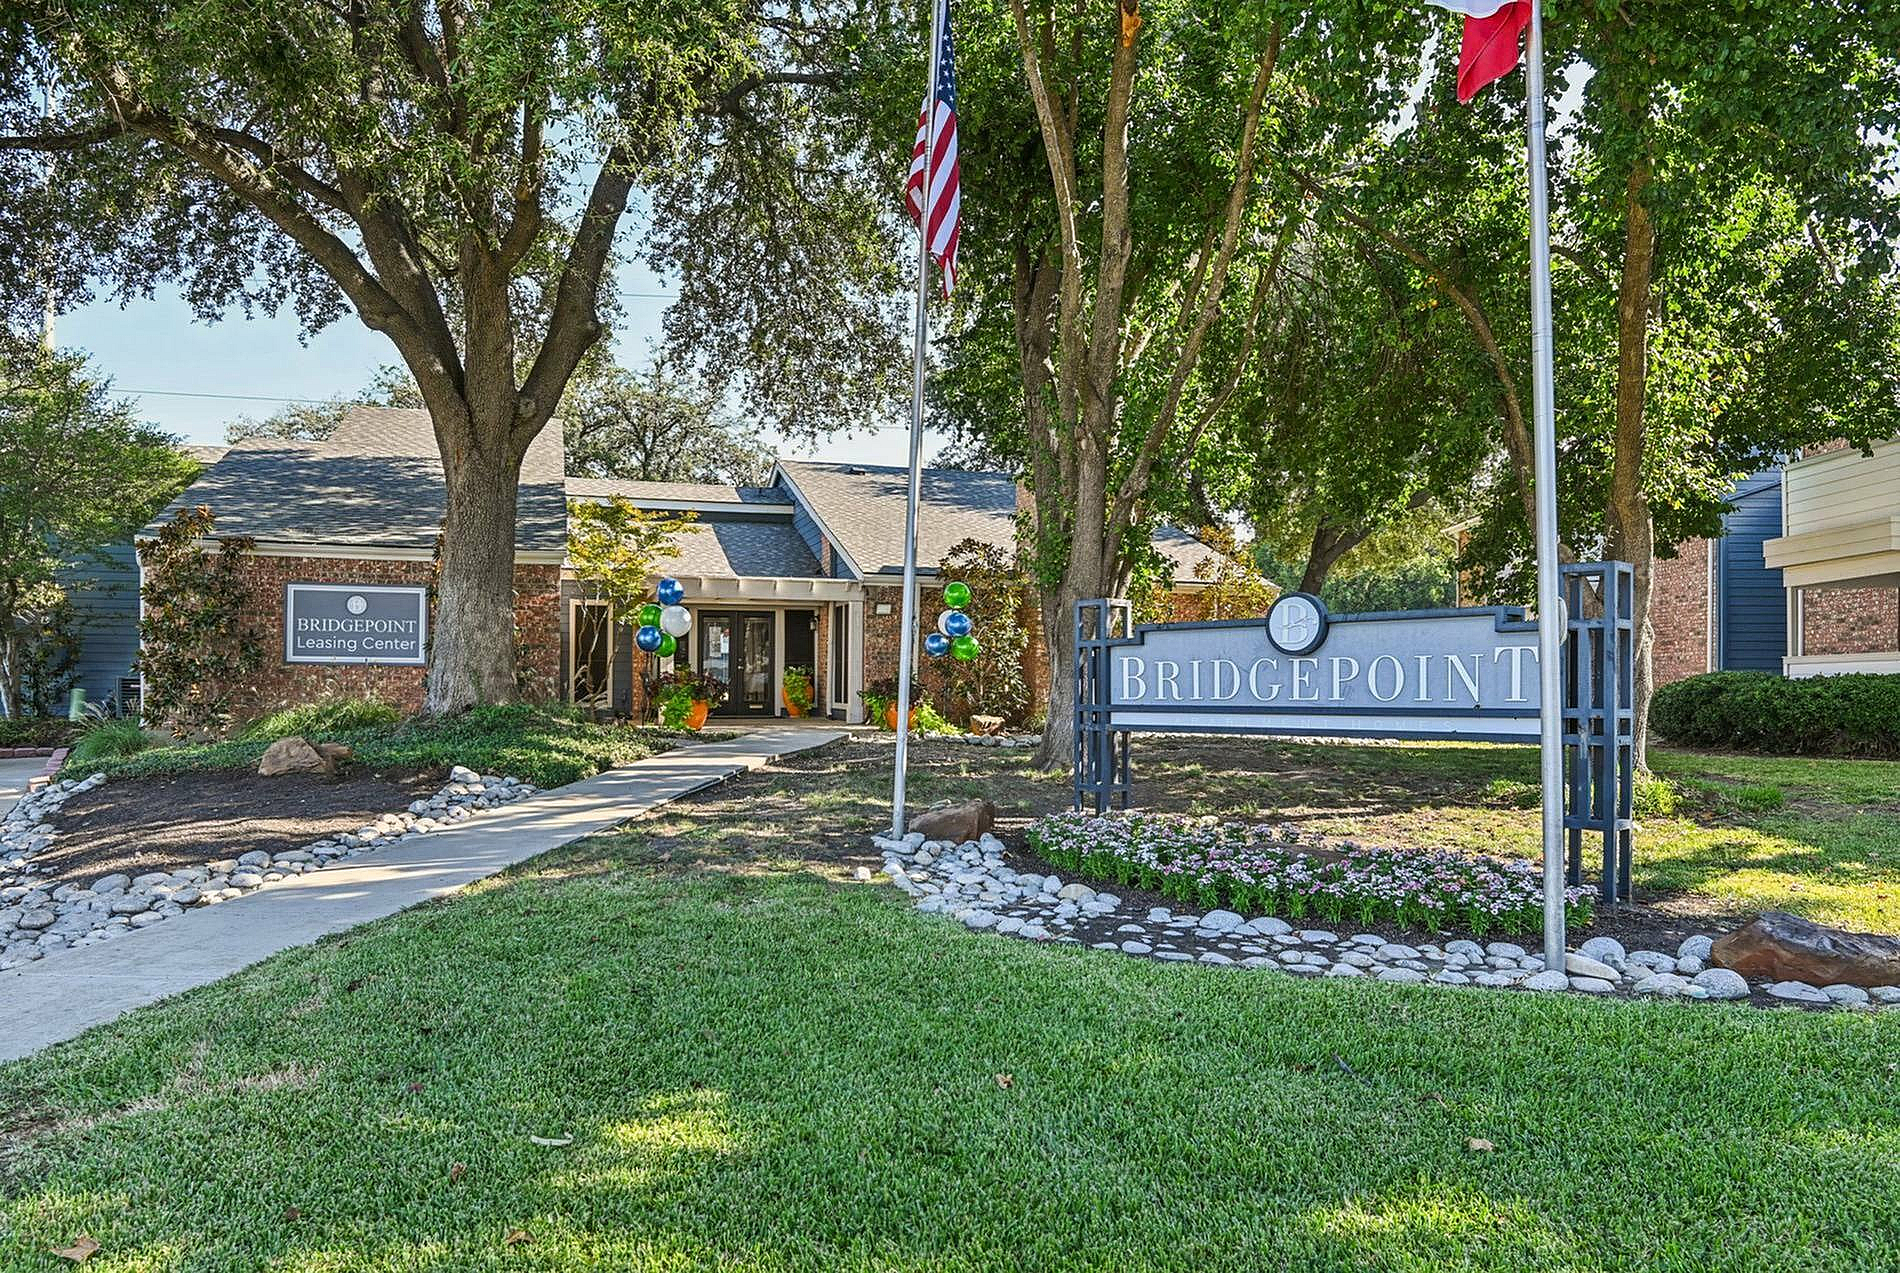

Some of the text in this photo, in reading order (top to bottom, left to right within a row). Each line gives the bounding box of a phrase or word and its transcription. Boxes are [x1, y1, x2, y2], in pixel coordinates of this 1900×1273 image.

[297, 617, 417, 633] BRIDGEPOINT
[297, 635, 417, 652] Leasing Center
[1118, 645, 1540, 703] BRIDGEPOINT
